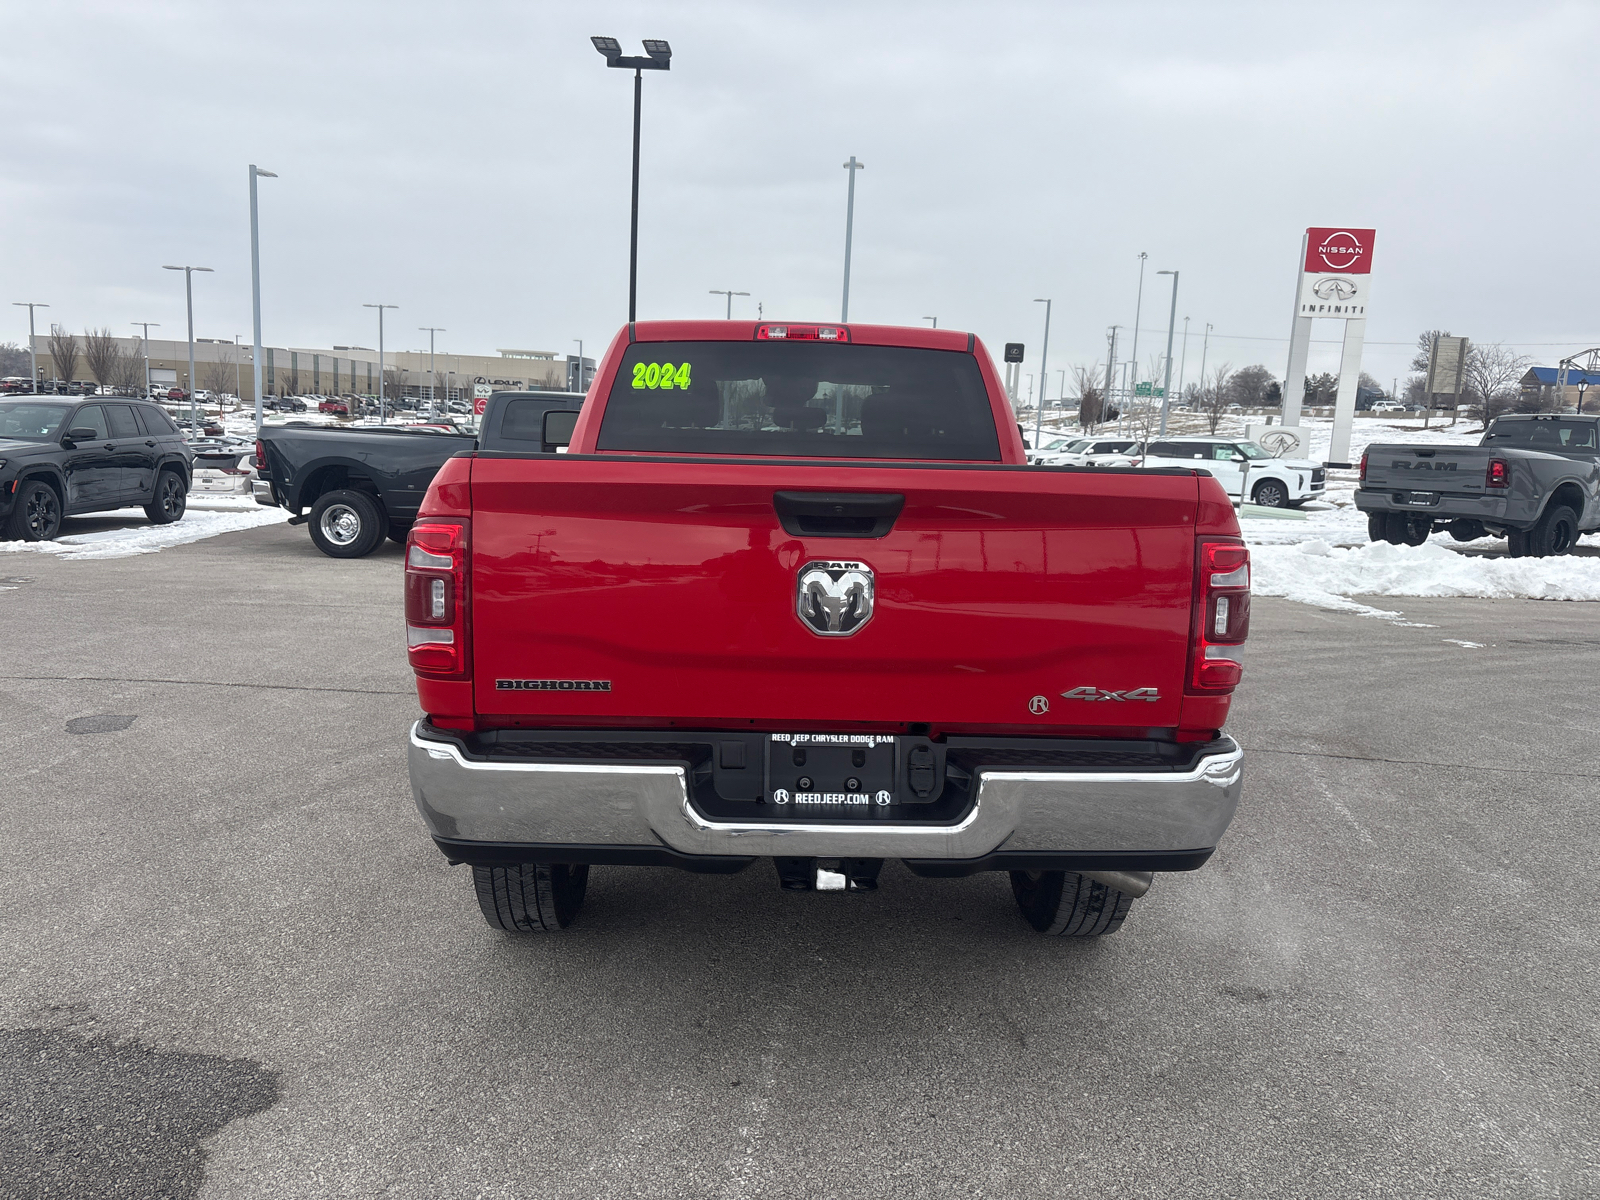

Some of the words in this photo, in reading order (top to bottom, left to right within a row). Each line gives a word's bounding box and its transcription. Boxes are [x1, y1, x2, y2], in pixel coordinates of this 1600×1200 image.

[1318, 246, 1363, 254] NISSAN
[1302, 304, 1364, 314] INFINITI
[631, 362, 691, 390] 2024
[1391, 460, 1458, 471] RAM
[495, 679, 611, 691] BIGHORN
[1060, 686, 1162, 702] 4x4
[772, 733, 791, 742] REED
[793, 734, 810, 742] JEEP
[811, 734, 849, 743] CHRYSLER
[850, 735, 874, 743] DODGE
[876, 735, 894, 743] RAM
[795, 793, 869, 804] REEDJEEP.COM
